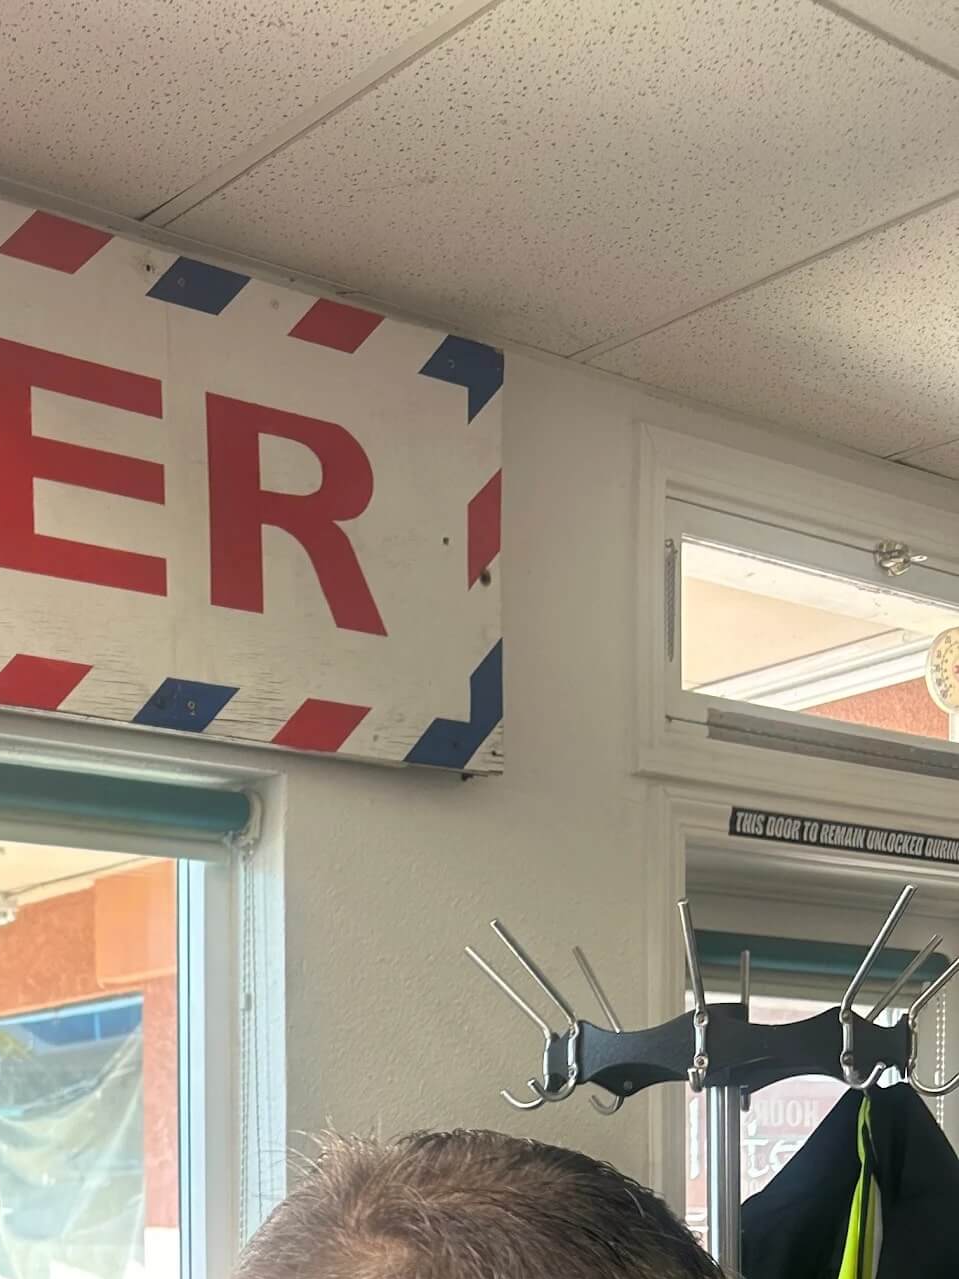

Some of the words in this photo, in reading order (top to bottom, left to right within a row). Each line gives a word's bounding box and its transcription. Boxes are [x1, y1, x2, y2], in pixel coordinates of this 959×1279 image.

[735, 811, 765, 835] THIS
[765, 815, 801, 840] DOOR
[803, 821, 819, 843] TO
[820, 824, 866, 849] REMAIN
[866, 830, 924, 856] UNLOCKED
[924, 837, 959, 861] DURIN
